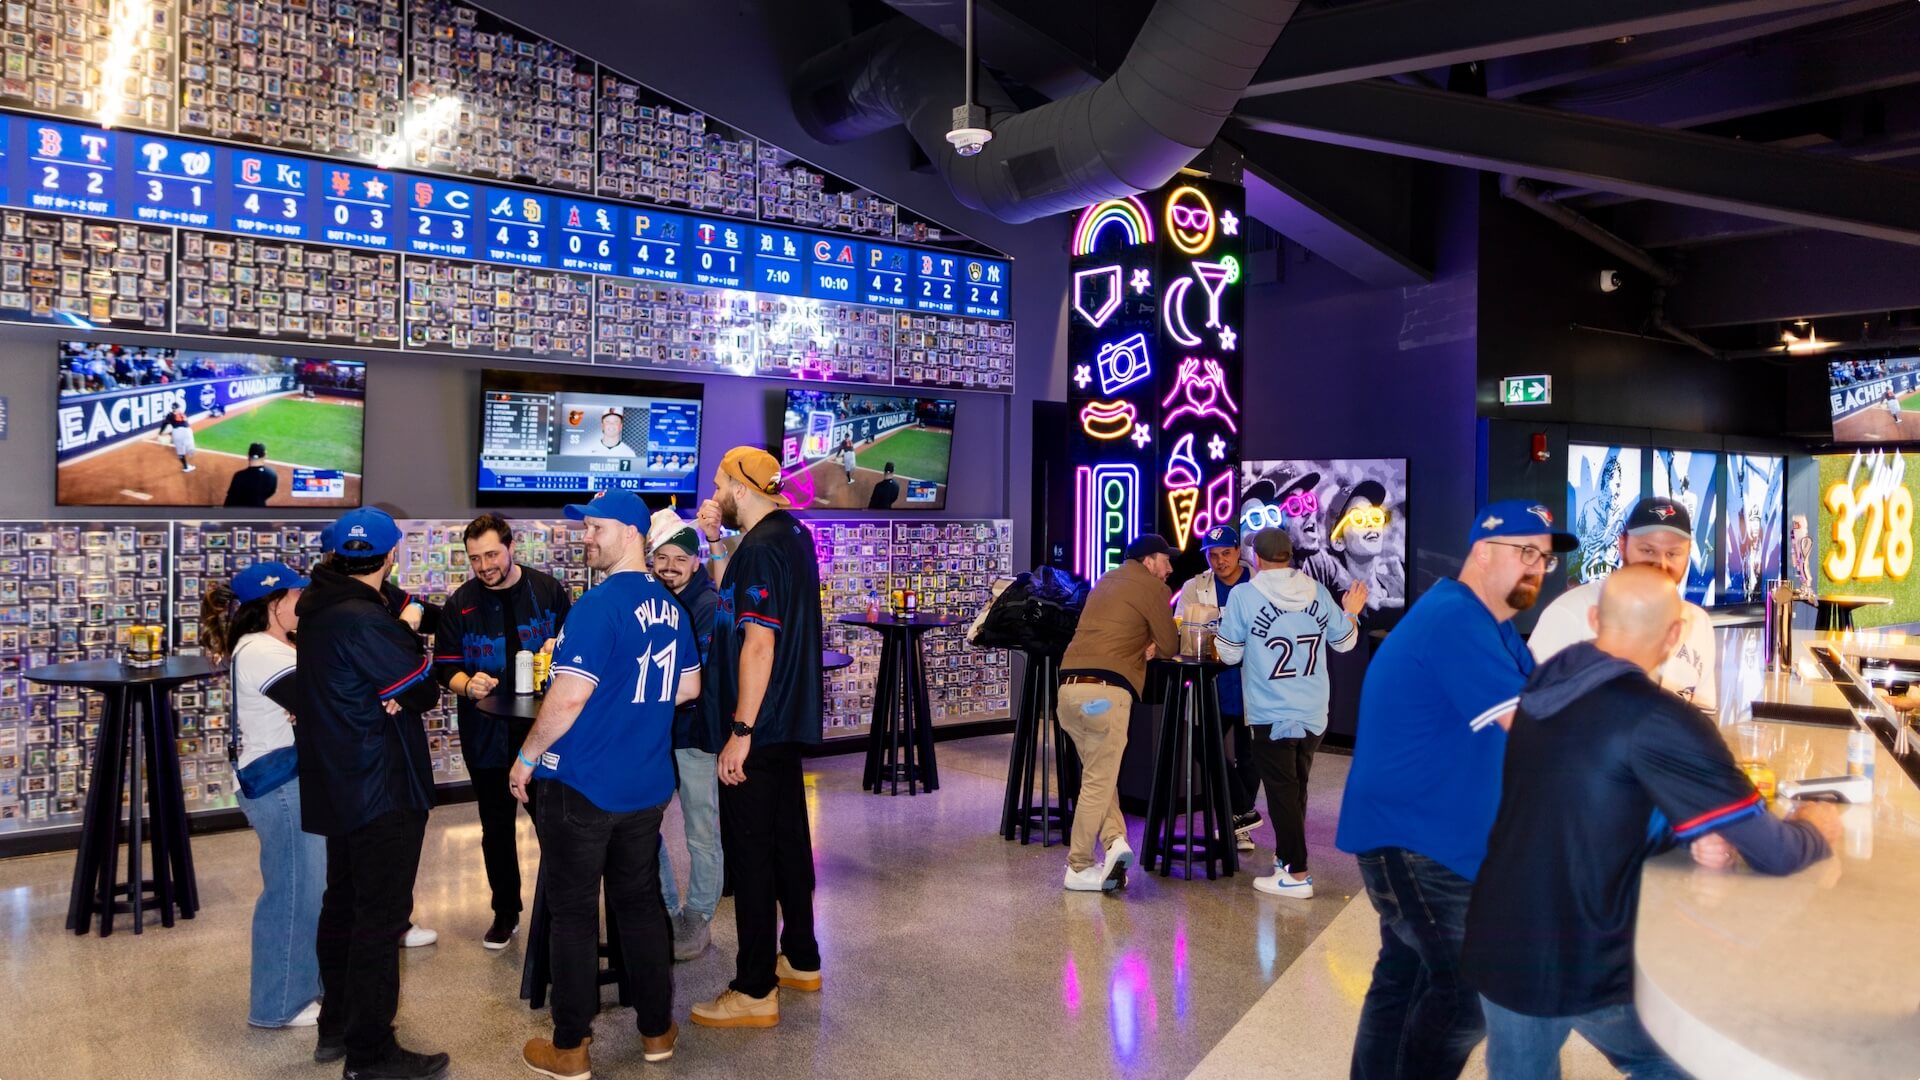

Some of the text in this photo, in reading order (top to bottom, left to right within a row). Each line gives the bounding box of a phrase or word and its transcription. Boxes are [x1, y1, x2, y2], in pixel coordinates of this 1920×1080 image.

[81, 135, 107, 162] T
[141, 143, 168, 171] P
[42, 167, 103, 194] 2 2
[241, 158, 261, 184] C
[147, 180, 201, 206] 3 1
[444, 190, 470, 209] C
[244, 194, 297, 218] 4 3
[334, 205, 383, 229] 0 3
[567, 204, 582, 227] A
[418, 215, 464, 239] 2 3
[635, 215, 650, 236] P
[496, 226, 539, 248] 4 3
[569, 235, 610, 257] 0 6
[637, 245, 675, 265] 4 2
[702, 252, 735, 272] 0 1
[814, 240, 854, 263] C A
[871, 249, 883, 267] P
[766, 268, 790, 284] 7:10
[941, 258, 953, 277] T
[820, 275, 848, 291] 10:10
[872, 275, 902, 293] 4 2
[923, 281, 951, 299] 2 2
[971, 287, 998, 304] 2 4
[228, 378, 267, 399] CANADA
[266, 377, 282, 391] DRY
[1830, 380, 1894, 417] EACHERS
[58, 388, 187, 452] EACHERS
[877, 413, 898, 429] CANADA
[898, 412, 907, 423] DRY
[622, 461, 628, 470] 7
[620, 479, 638, 488] 002
[1104, 479, 1125, 572] OPE
[1824, 480, 1914, 584] 328
[1264, 633, 1322, 681] 27
[631, 638, 677, 703] 11
